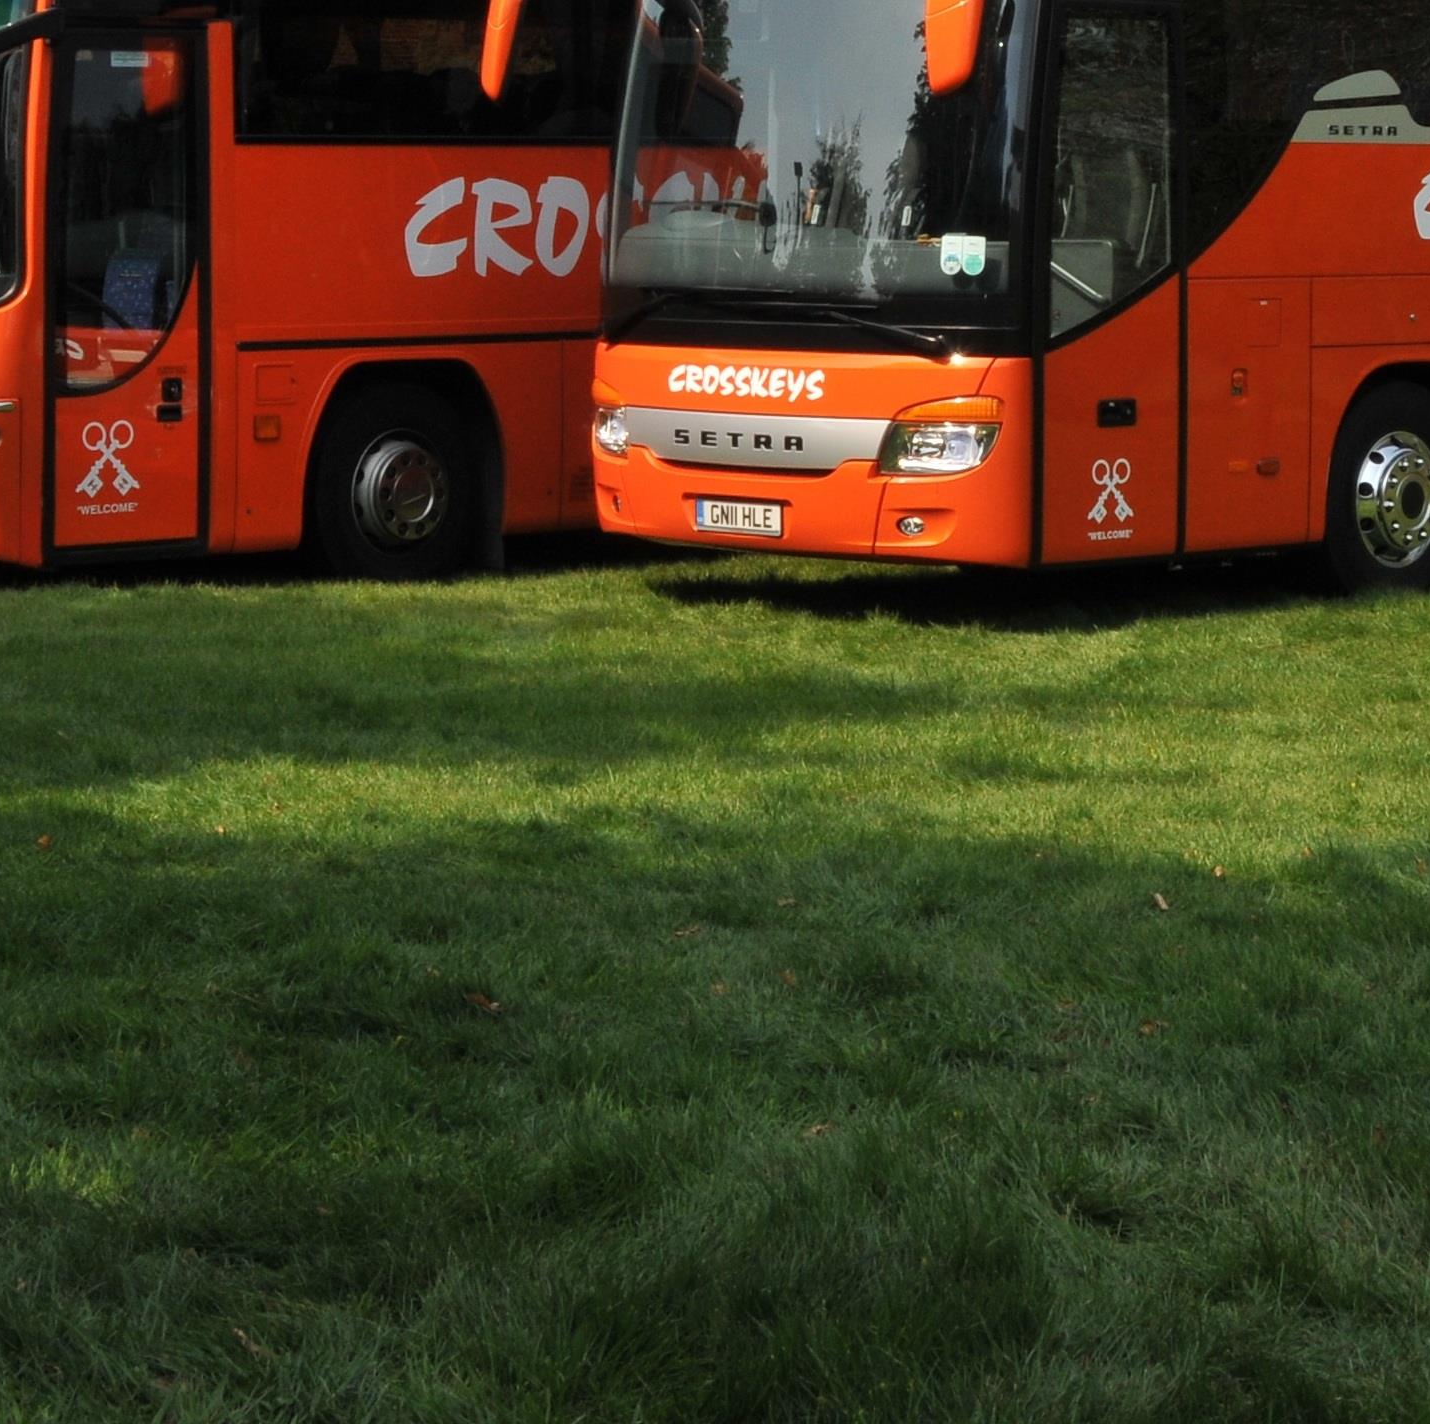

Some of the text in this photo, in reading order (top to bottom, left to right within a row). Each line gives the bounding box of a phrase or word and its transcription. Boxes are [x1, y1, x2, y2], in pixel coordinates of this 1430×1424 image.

[1328, 125, 1398, 137] SETRA
[668, 365, 825, 402] CROSSKEYS
[674, 429, 804, 451] SETRA
[711, 505, 773, 529] GN11 HLE
